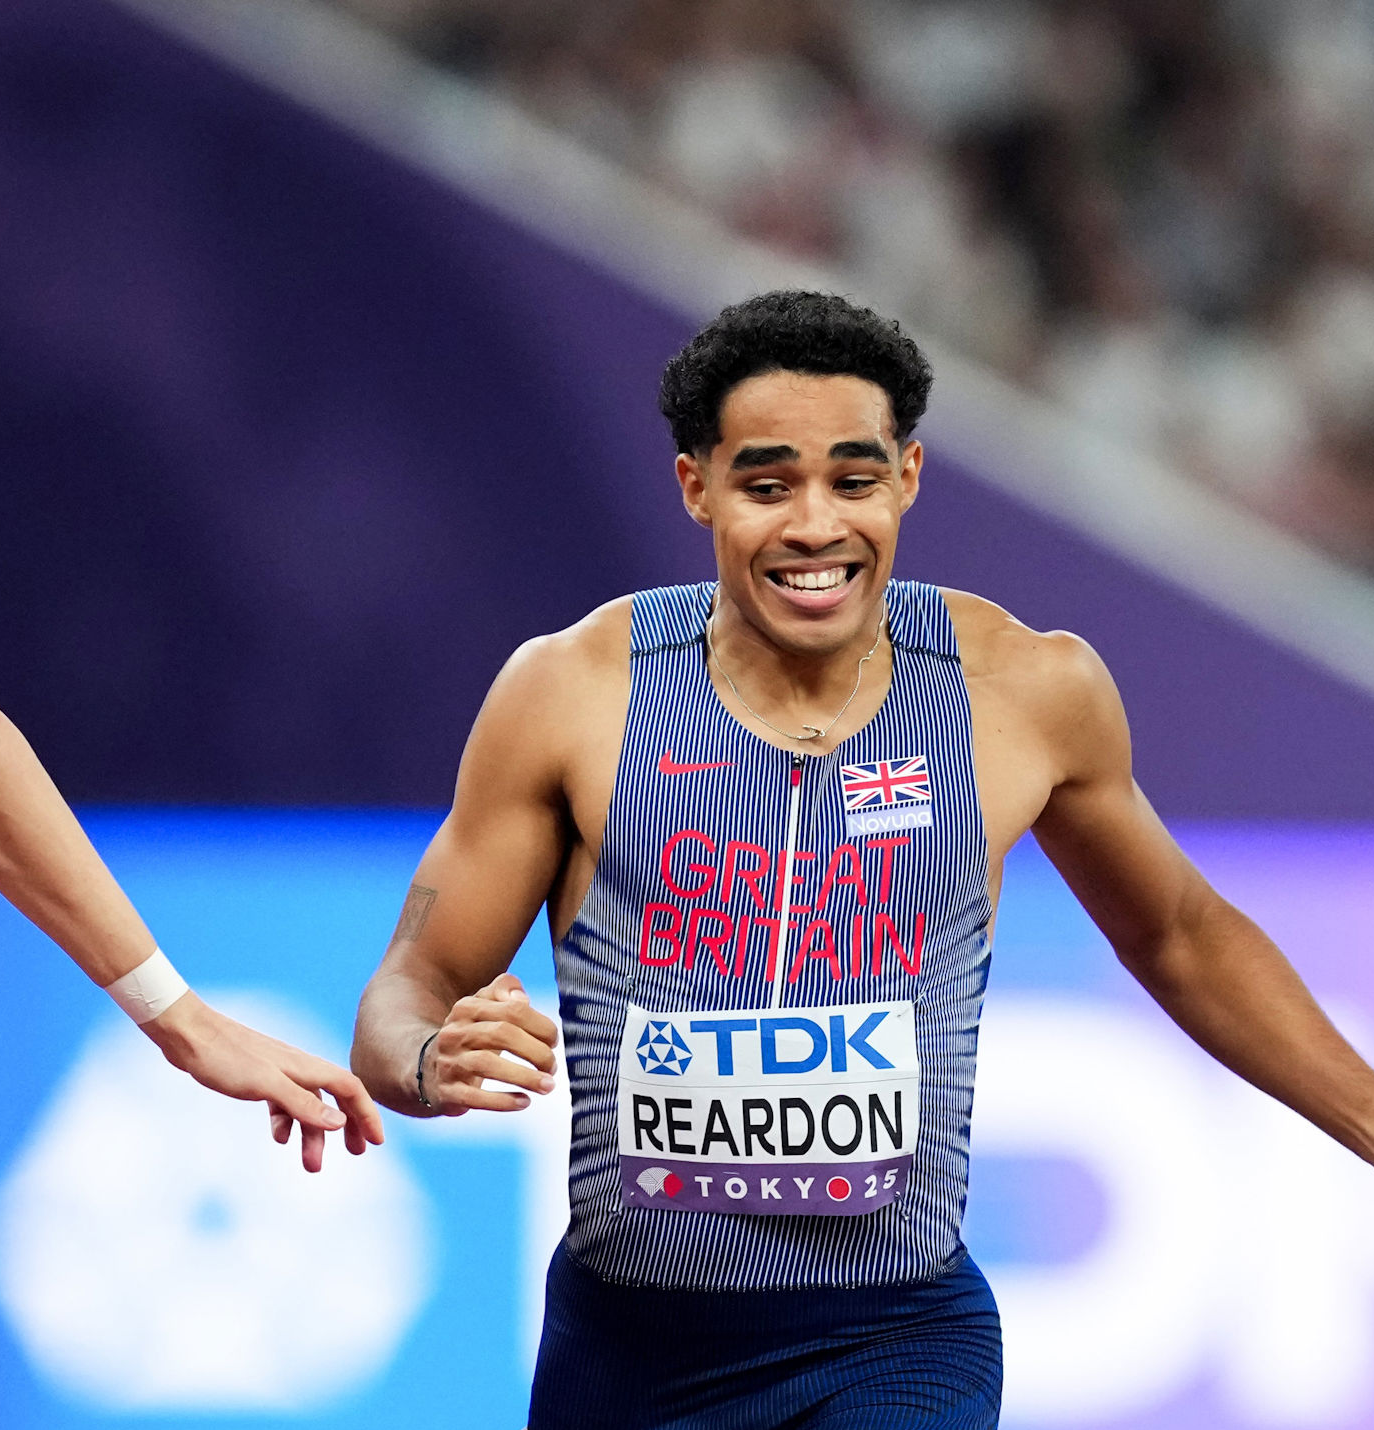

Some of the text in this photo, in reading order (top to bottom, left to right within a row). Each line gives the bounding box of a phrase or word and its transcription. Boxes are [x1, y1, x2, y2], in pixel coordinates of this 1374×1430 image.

[848, 810, 931, 834] Novuna
[660, 829, 910, 915] GREAT
[639, 902, 925, 984] BRITAIN
[689, 1011, 896, 1076] TDK
[632, 1091, 904, 1157] REARDON
